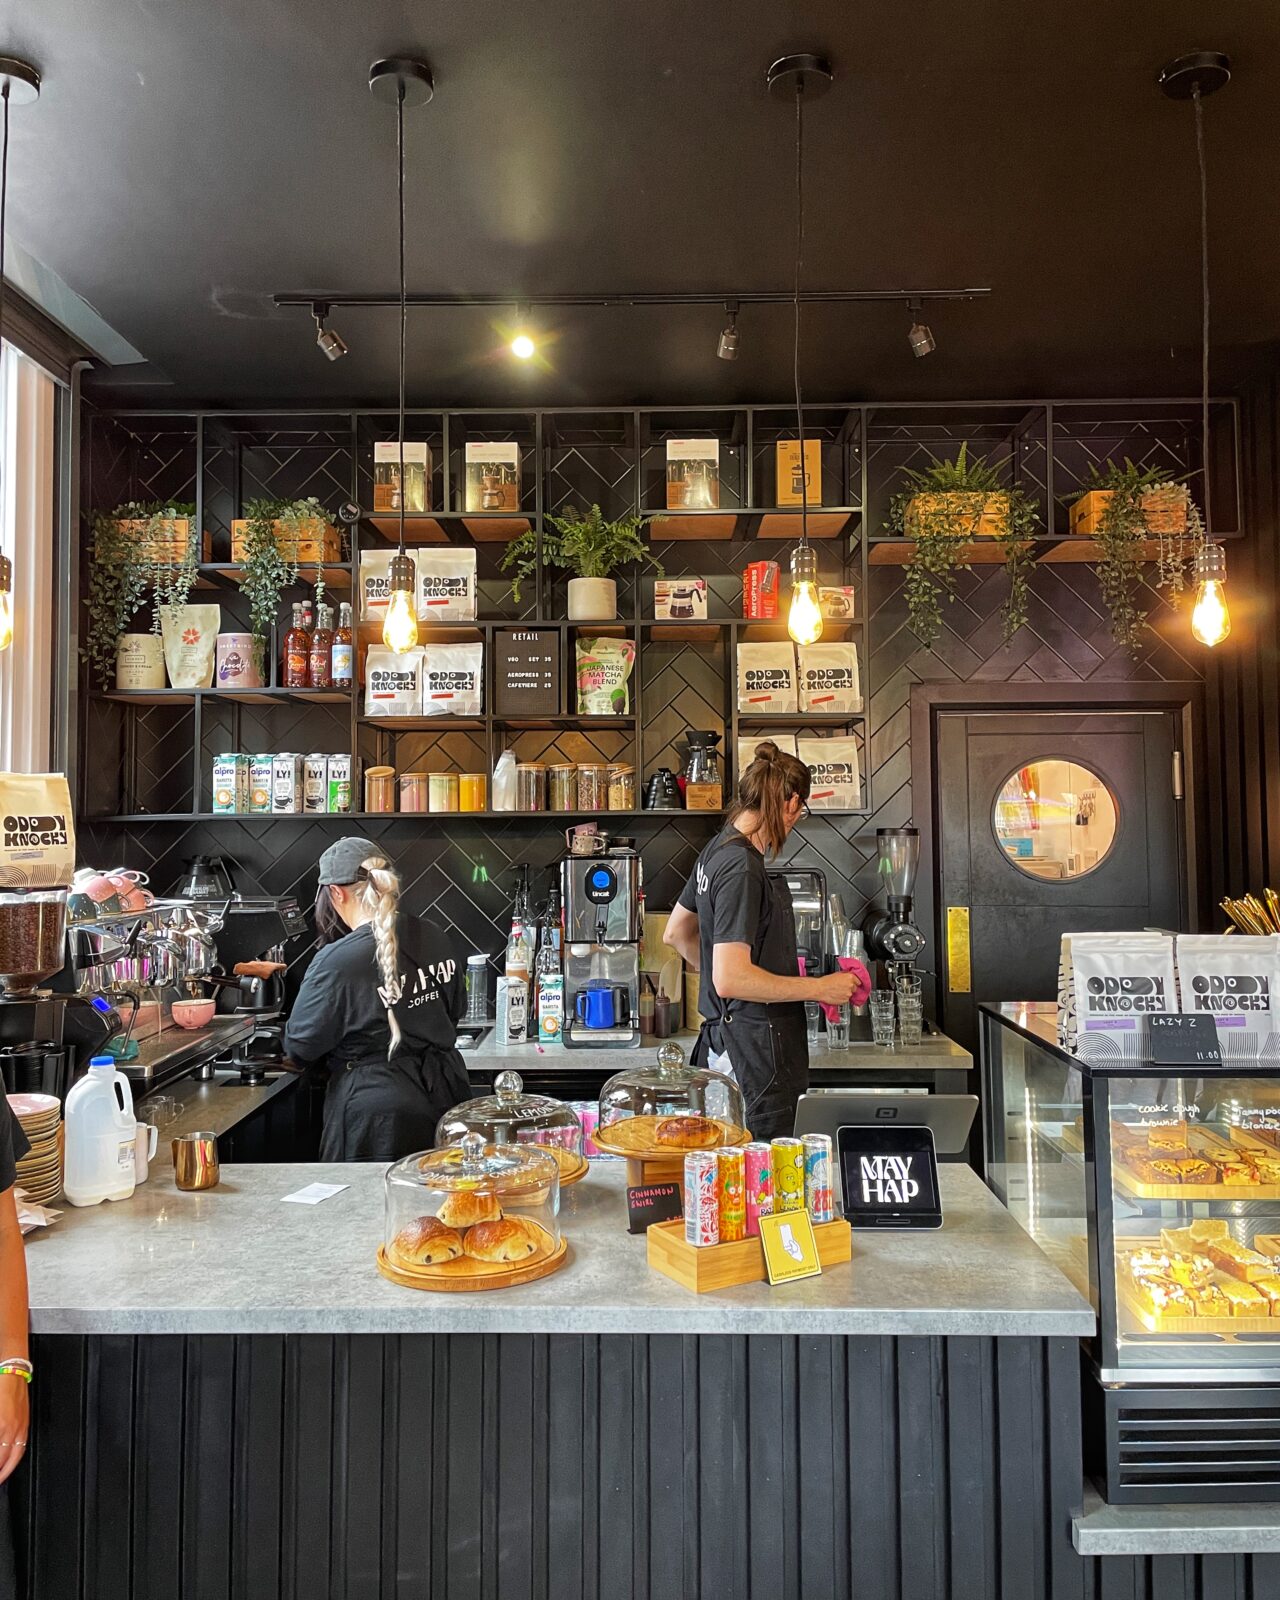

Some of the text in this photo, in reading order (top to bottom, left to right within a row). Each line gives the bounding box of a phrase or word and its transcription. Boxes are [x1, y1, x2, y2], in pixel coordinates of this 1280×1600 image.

[365, 577, 388, 588] OD
[422, 577, 468, 588] ODDY
[365, 588, 390, 598] KNO
[423, 587, 468, 597] KNOCKY
[512, 632, 539, 641] RETAIL
[371, 671, 416, 682] ODDY
[429, 671, 475, 682] ODDY
[745, 669, 791, 681] ODDY
[806, 668, 853, 681] ODDY
[371, 681, 416, 691] KNOCKY
[429, 681, 475, 691] KNOCKY
[746, 680, 791, 690] KNOCKY
[807, 680, 853, 690] KNOCKY
[214, 767, 235, 776] alpro
[250, 767, 271, 776] alpro
[276, 770, 291, 779] LY!
[308, 770, 323, 779] LY!
[332, 770, 347, 779] LY!
[3, 815, 66, 832] ODDY
[4, 832, 68, 847] KNOCKY
[1087, 976, 1164, 995] ODDY
[1191, 975, 1270, 995] ODDY
[511, 996, 525, 1006] LY!
[540, 992, 561, 1002] alpro
[1088, 996, 1166, 1012] KNOCKY
[1194, 995, 1270, 1011] KNOCKY
[1152, 1016, 1183, 1027] LAZY
[1196, 1050, 1219, 1060] 11.00
[1138, 1103, 1200, 1118] cookie dough
[1140, 1117, 1180, 1126] brownie
[860, 1155, 913, 1180] MAY
[630, 1186, 674, 1199] CINNAMON
[862, 1179, 919, 1203] HAP
[631, 1199, 654, 1208] SWIRL
